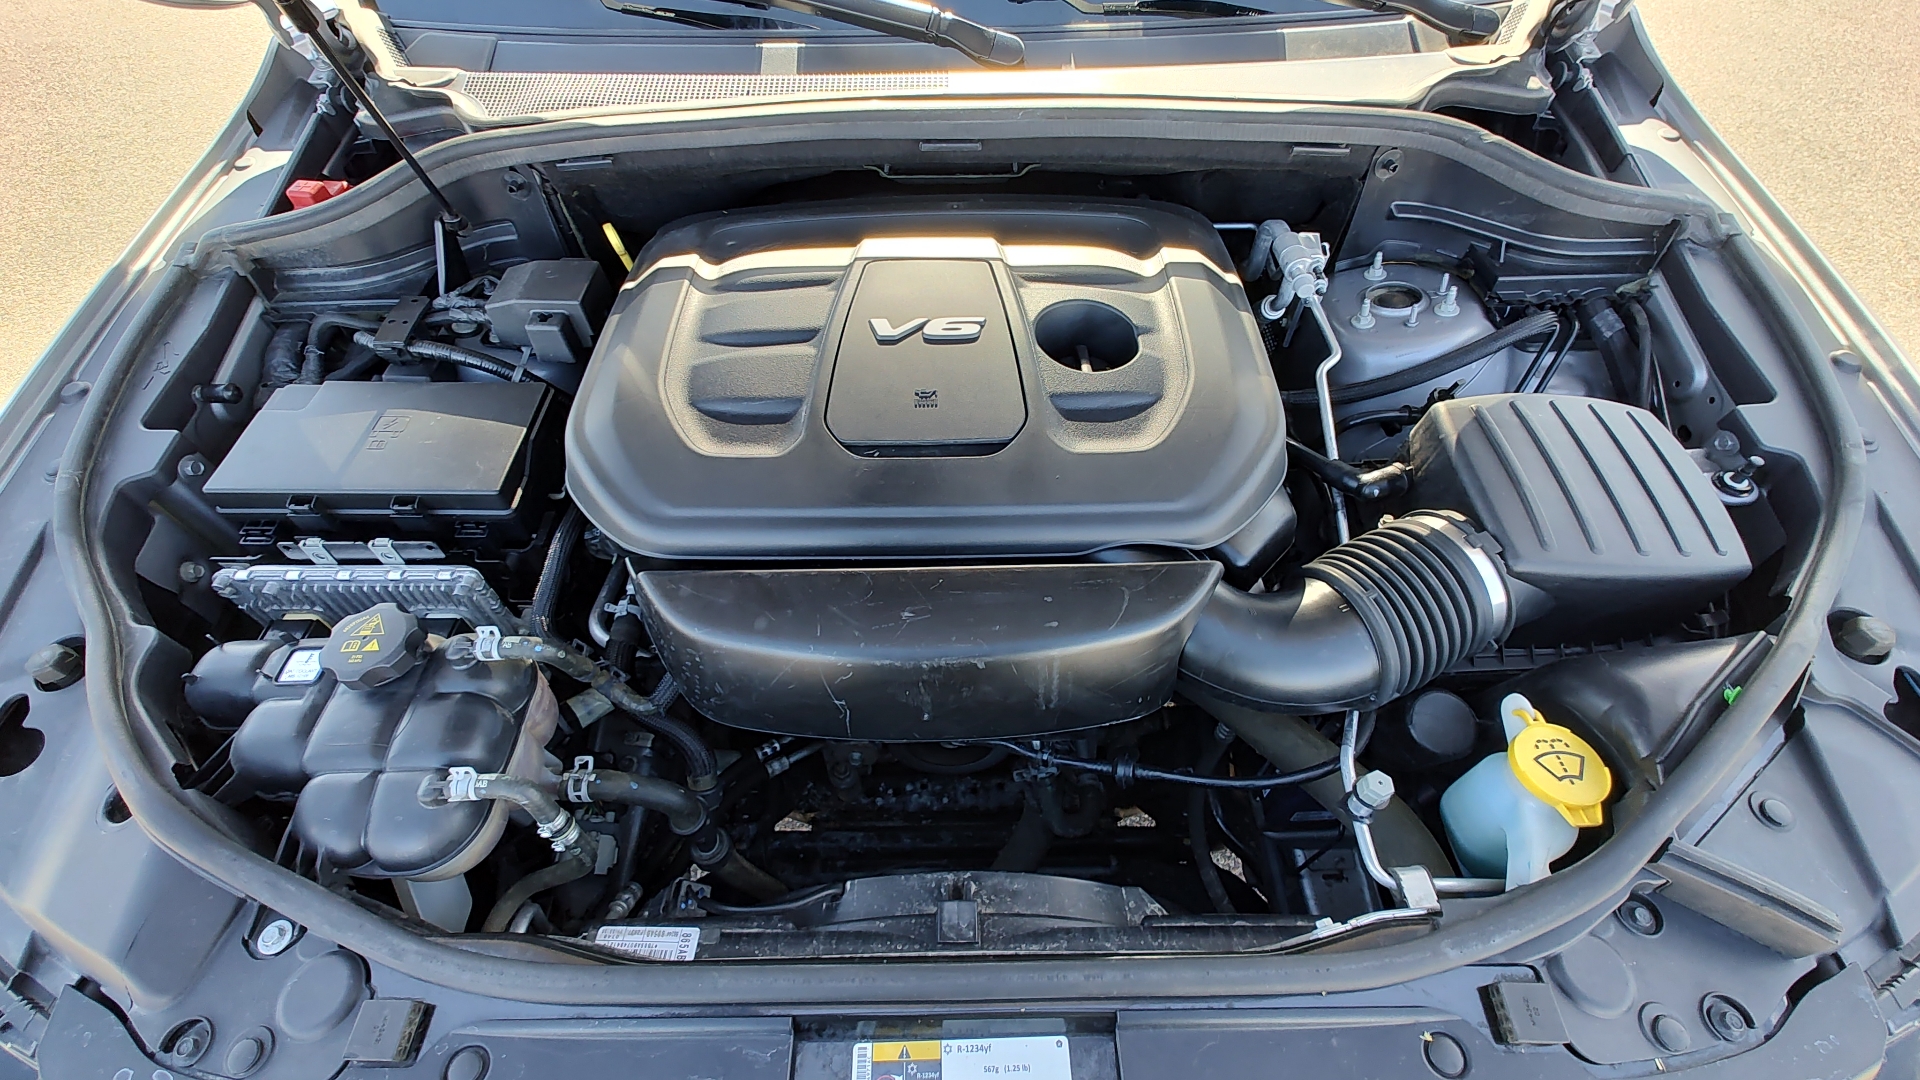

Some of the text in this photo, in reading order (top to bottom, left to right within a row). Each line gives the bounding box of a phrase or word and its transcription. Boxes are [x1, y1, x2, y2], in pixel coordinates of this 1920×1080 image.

[868, 316, 987, 346] V6
[957, 1043, 992, 1055] R-1234yf
[983, 1063, 1031, 1074] 567g (1.25 lb)
[916, 1072, 940, 1080] R-1234yf
